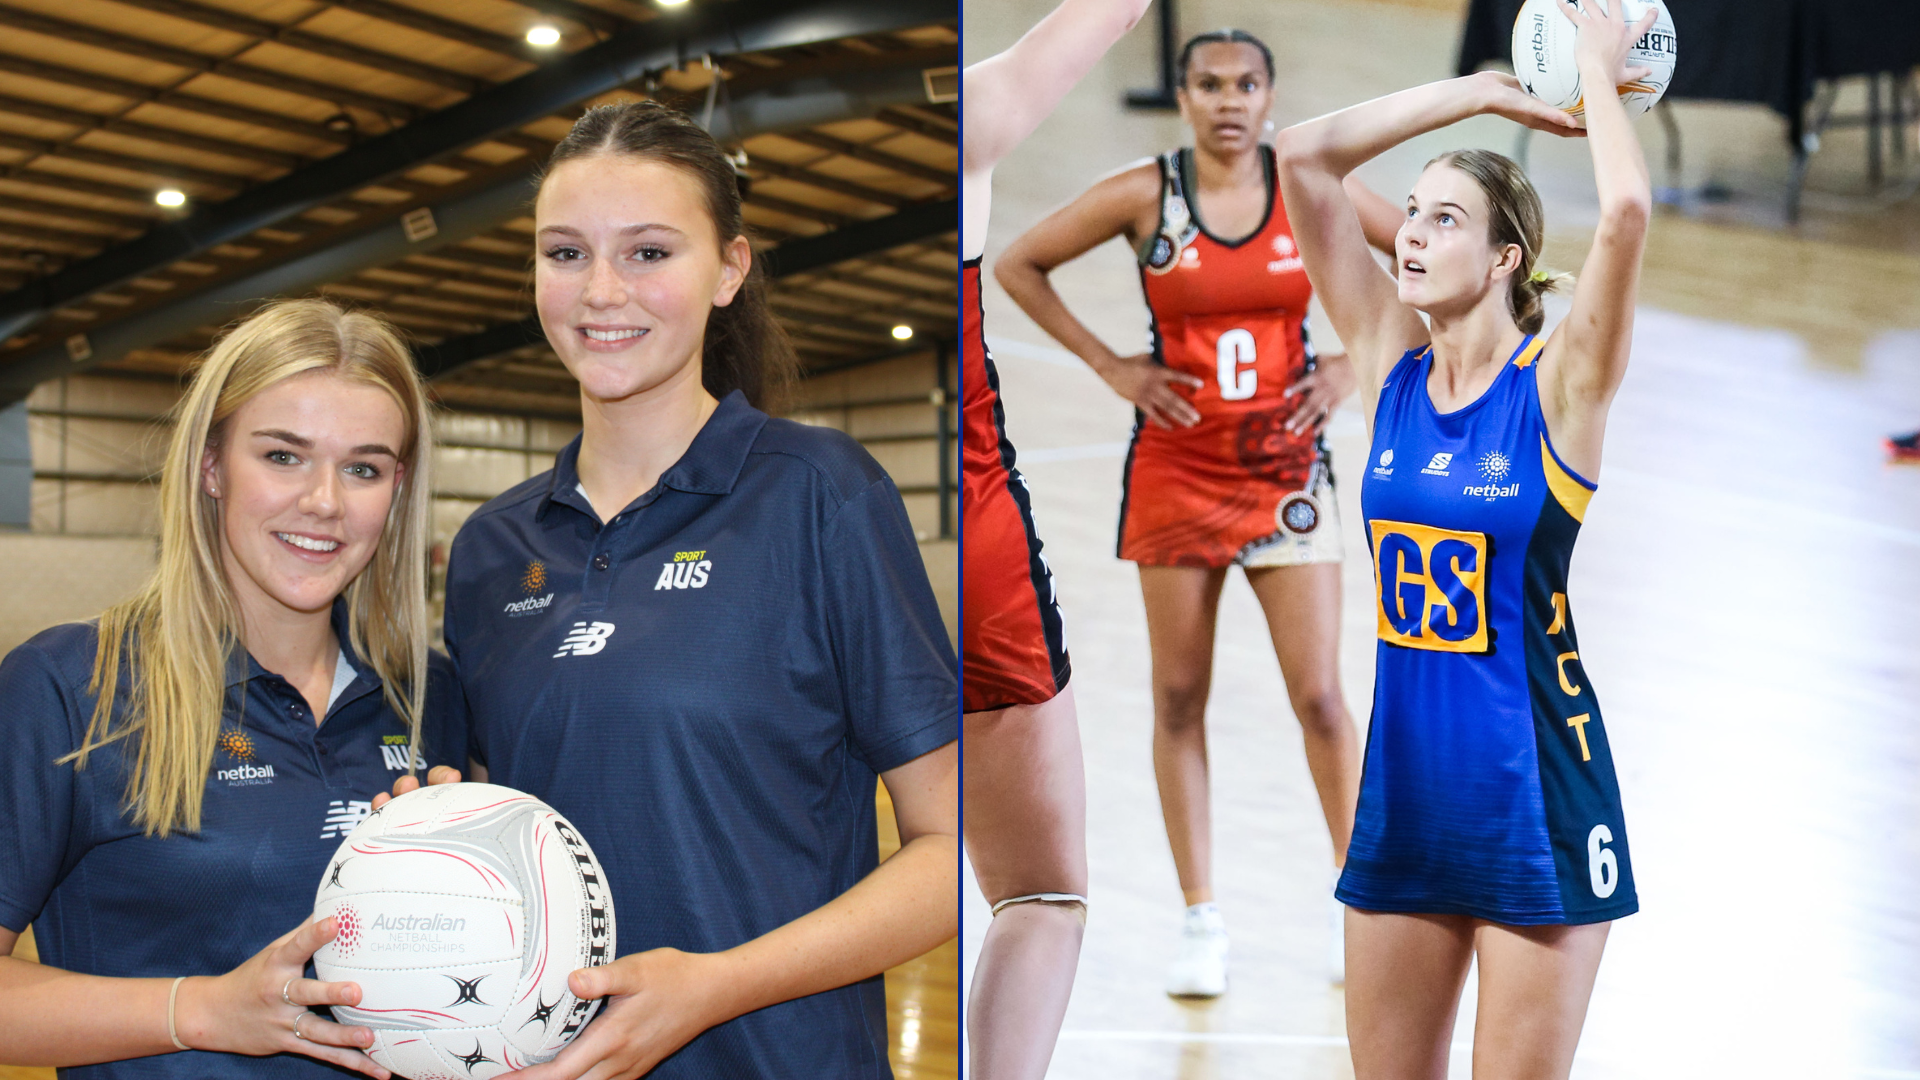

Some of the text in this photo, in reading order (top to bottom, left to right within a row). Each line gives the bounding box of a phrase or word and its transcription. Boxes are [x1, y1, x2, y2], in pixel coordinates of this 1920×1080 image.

[1532, 13, 1547, 73] netball
[1217, 328, 1257, 400] C
[1463, 483, 1520, 497] netball
[673, 551, 706, 562] SPORT
[654, 560, 712, 590] AUS
[1379, 532, 1479, 642] GS
[504, 593, 554, 612] netball
[508, 609, 544, 618] AUSTRALIA
[382, 735, 408, 745] SPORT
[378, 745, 428, 771] AUS
[217, 764, 275, 781] netball
[228, 778, 273, 787] AUSTRALIA
[1587, 824, 1618, 899] 6
[370, 912, 466, 931] Australian
[389, 932, 442, 943] NETBALL
[370, 942, 466, 953] CHAMPIONSHIPS
